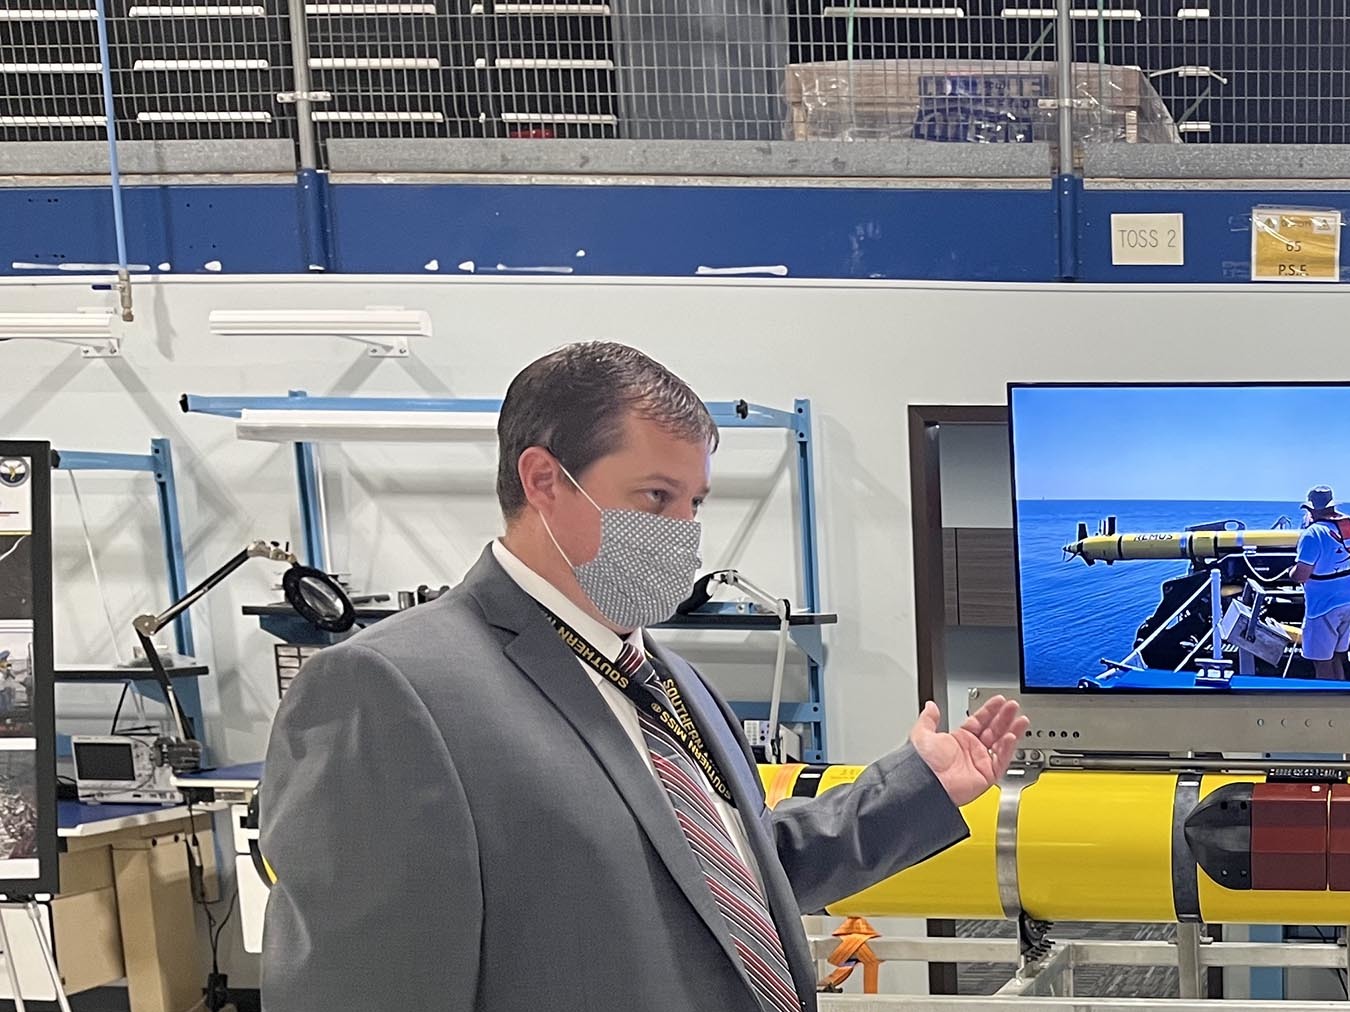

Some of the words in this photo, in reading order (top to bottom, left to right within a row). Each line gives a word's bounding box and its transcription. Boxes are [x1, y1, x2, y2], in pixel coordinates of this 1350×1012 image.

[1117, 229, 1159, 248] TOSS
[1167, 229, 1176, 248] 2
[1286, 241, 1302, 252] 65
[558, 626, 629, 689] SOUTHERN
[660, 711, 687, 742] MISS
[663, 678, 704, 749] SOUTHERN
